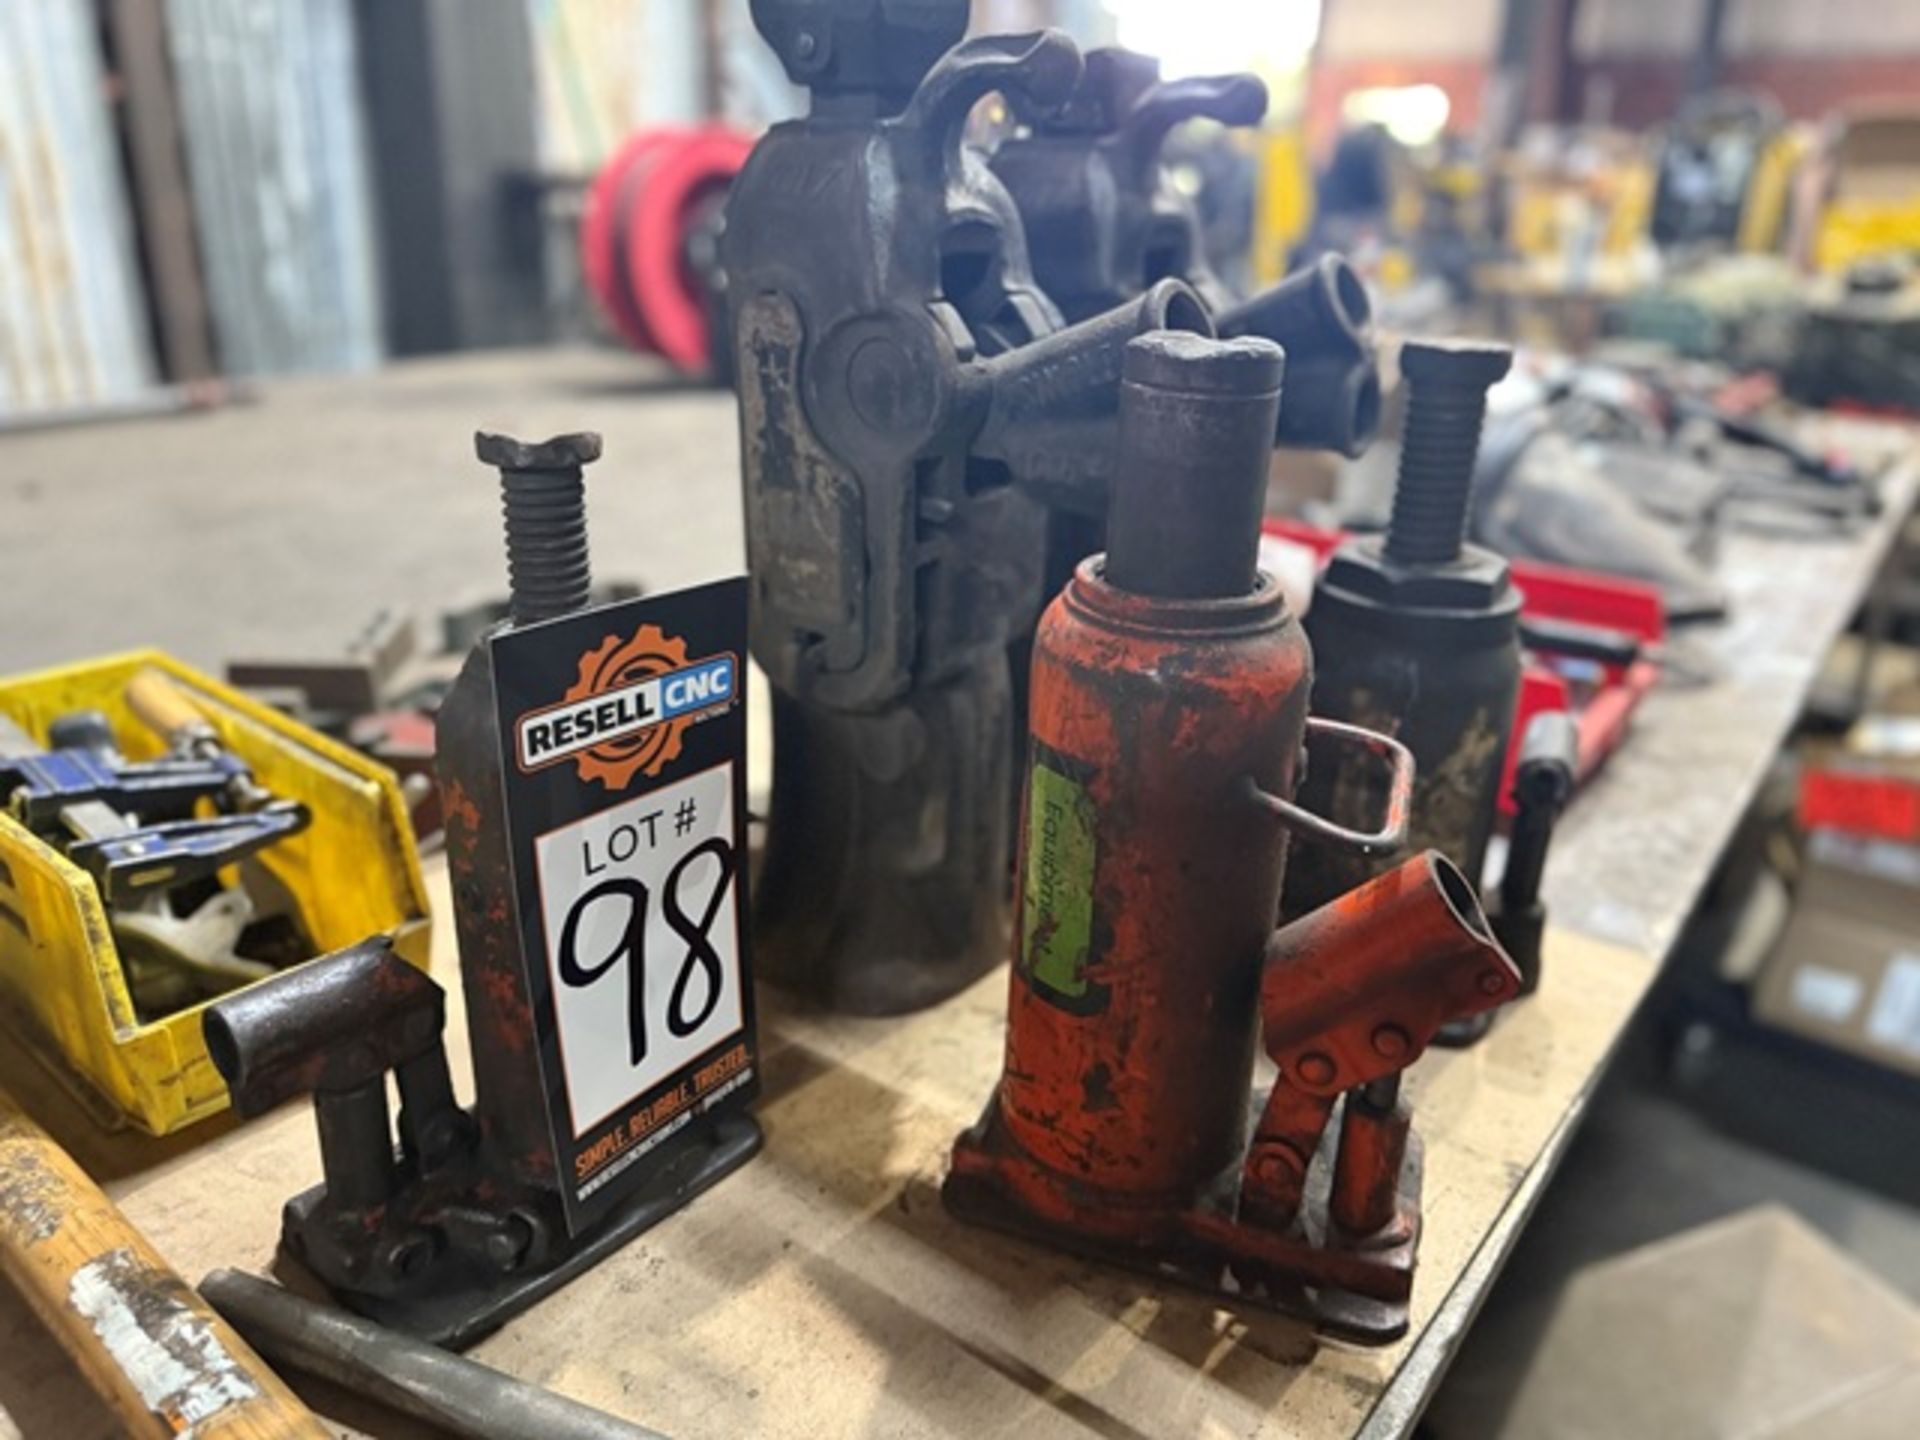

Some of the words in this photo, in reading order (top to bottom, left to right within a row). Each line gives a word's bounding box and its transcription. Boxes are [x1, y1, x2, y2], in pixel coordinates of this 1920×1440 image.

[528, 692, 654, 757] RESELL
[665, 666, 728, 708] CNC
[583, 810, 663, 876] LOT
[674, 797, 697, 837] #
[558, 836, 736, 1067] 98
